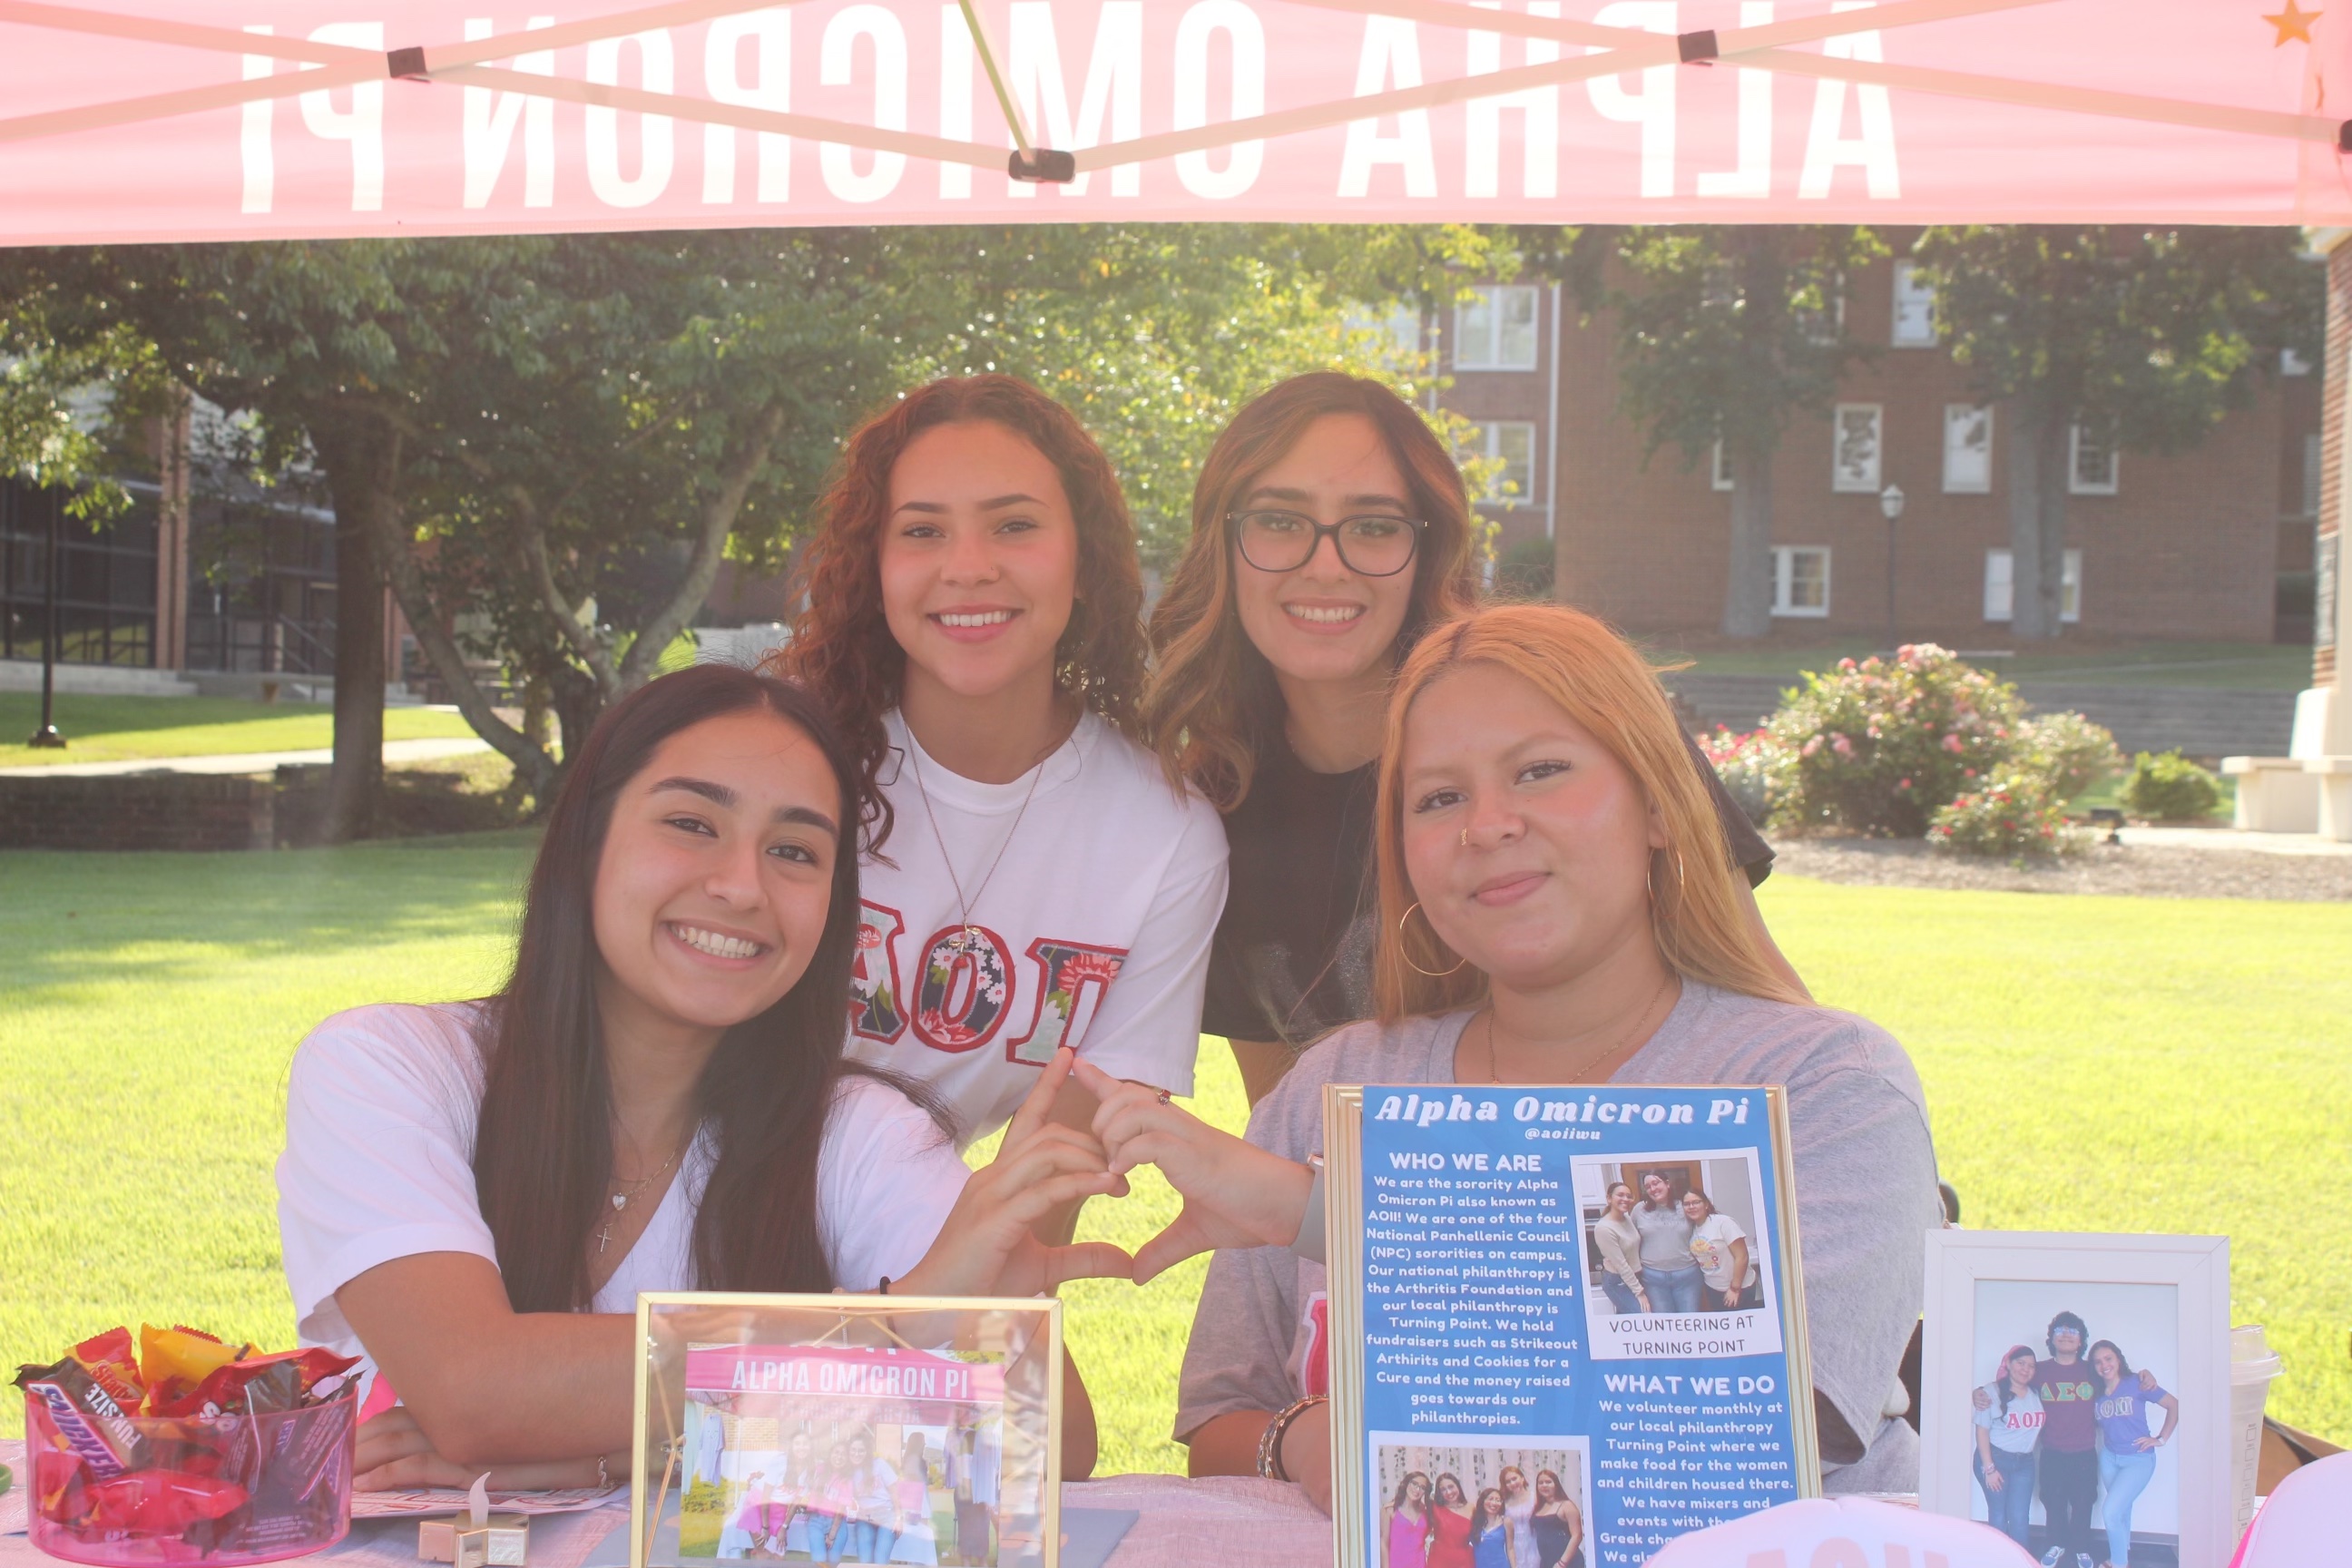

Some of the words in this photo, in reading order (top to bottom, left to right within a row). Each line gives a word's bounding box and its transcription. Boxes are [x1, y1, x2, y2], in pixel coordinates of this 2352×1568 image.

[1375, 1094, 1497, 1126] Alpha
[1514, 1095, 1693, 1123] Omicron
[1707, 1098, 1749, 1123] Pi
[1525, 1128, 1600, 1140] @aoiiwu
[1389, 1152, 1445, 1170] WHO
[1453, 1154, 1489, 1171] WE
[1496, 1155, 1541, 1171] ARE
[1375, 1176, 1396, 1187] We
[1428, 1178, 1451, 1188] the
[1456, 1179, 1512, 1191] sorority
[1517, 1180, 1557, 1191] Alpha
[1378, 1194, 1436, 1205] Omicron
[1441, 1196, 1453, 1206] Pi
[1458, 1197, 1485, 1207] also
[1491, 1197, 1535, 1206] known
[1406, 1213, 1426, 1223] We
[1490, 1213, 1504, 1223] of
[1509, 1213, 1532, 1223] the
[1537, 1213, 1567, 1223] four
[1367, 1228, 1426, 1240] National
[1431, 1231, 1513, 1241] Panhellenic
[1518, 1231, 1570, 1241] Council
[1371, 1247, 1410, 1260] (NPC)
[1416, 1248, 1484, 1259] sororities
[1510, 1252, 1565, 1262] campus.
[1368, 1265, 1394, 1275] Our
[1399, 1266, 1458, 1276] national
[1464, 1266, 1553, 1280] philanthropy
[1367, 1282, 1389, 1293] the
[1395, 1283, 1456, 1293] Arthritis
[1461, 1284, 1542, 1295] Foundation
[1547, 1286, 1573, 1296] and
[1412, 1300, 1446, 1309] local
[1451, 1300, 1543, 1316] philanthropy
[1548, 1303, 1558, 1313] is
[1389, 1318, 1445, 1331] Turning
[1450, 1318, 1491, 1328] Point.
[1496, 1320, 1517, 1330] We
[1523, 1320, 1553, 1331] hold
[1609, 1317, 1730, 1333] VOLUNTEERING
[1736, 1315, 1754, 1329] AT
[1367, 1334, 1449, 1348] fundraisers
[1455, 1337, 1485, 1348] such
[1512, 1338, 1577, 1348] Strikeout
[1622, 1341, 1692, 1355] TURNING
[1698, 1339, 1745, 1354] POINT
[1377, 1353, 1438, 1366] Arthirits
[1444, 1356, 1468, 1366] and
[1475, 1356, 1529, 1367] Cookies
[1534, 1357, 1555, 1367] for
[731, 1360, 810, 1391] ALPHA
[819, 1363, 936, 1396] OMICRON
[946, 1369, 968, 1398] PI
[1377, 1372, 1410, 1383] Cure
[1416, 1374, 1440, 1384] and
[1446, 1375, 1468, 1385] the
[1475, 1378, 1521, 1388] money
[1526, 1376, 1570, 1386] raised
[1604, 1374, 1682, 1394] WHAT
[1690, 1377, 1730, 1395] WE
[1738, 1375, 1775, 1394] DO
[84, 1382, 119, 1421] SIZE
[1411, 1395, 1443, 1405] goes
[1449, 1394, 1507, 1405] towards
[1600, 1401, 1622, 1411] We
[1627, 1402, 1697, 1414] volunteer
[1702, 1403, 1761, 1416] monthly
[1768, 1403, 1782, 1412] at
[1412, 1411, 1520, 1426] philanthropies.
[44, 1386, 125, 1482] SNICKER
[110, 1411, 142, 1450] FUN
[1640, 1420, 1674, 1432] local
[1680, 1422, 1772, 1436] philanthropy
[1607, 1439, 1663, 1454] Turning
[1668, 1441, 1705, 1451] Point
[1710, 1441, 1754, 1451] where
[1602, 1458, 1638, 1469] make
[1643, 1458, 1675, 1470] food
[1681, 1460, 1702, 1470] for
[1708, 1460, 1731, 1470] the
[1737, 1462, 1787, 1470] women
[1598, 1477, 1623, 1487] and
[1629, 1477, 1687, 1489] children
[1692, 1479, 1744, 1489] housed
[1749, 1478, 1794, 1490] there.
[1622, 1497, 1644, 1507] We
[1651, 1497, 1685, 1508] have
[1743, 1497, 1769, 1509] and
[1618, 1516, 1667, 1526] events
[1672, 1516, 1703, 1527] with
[1601, 1533, 1642, 1544] Greek
[1604, 1552, 1627, 1562] We
